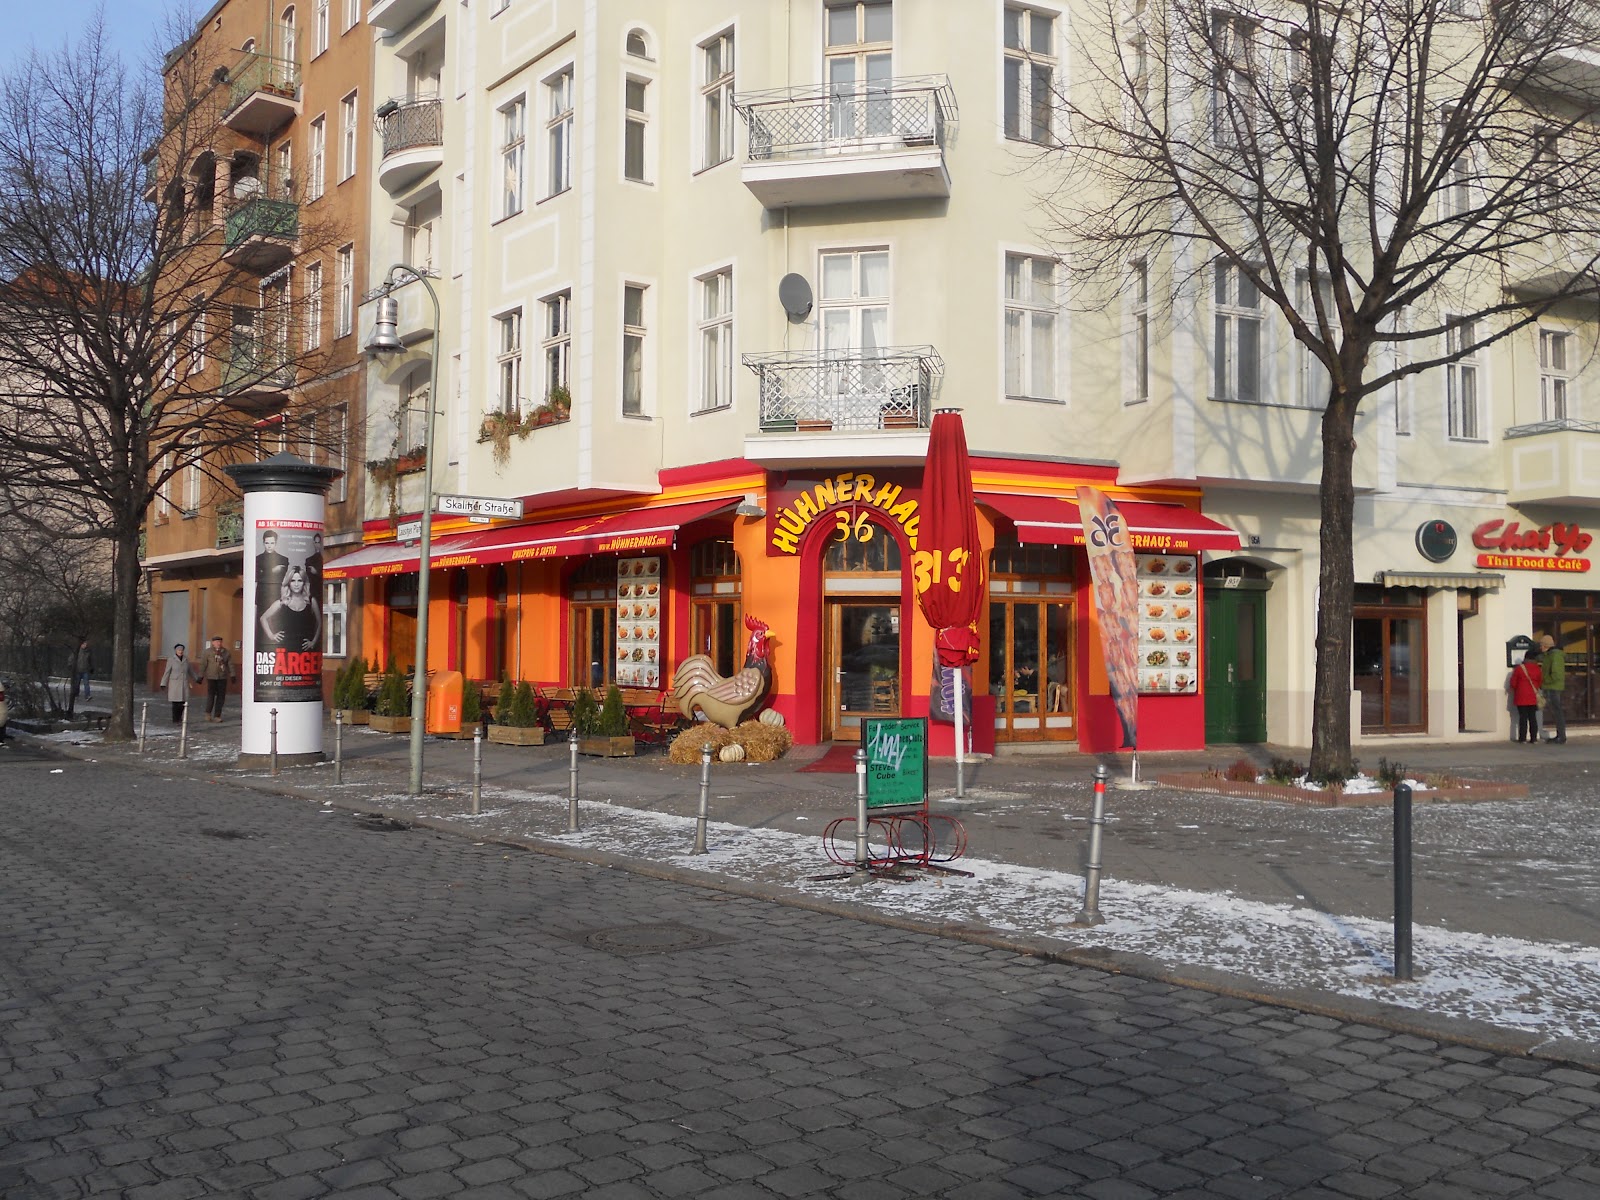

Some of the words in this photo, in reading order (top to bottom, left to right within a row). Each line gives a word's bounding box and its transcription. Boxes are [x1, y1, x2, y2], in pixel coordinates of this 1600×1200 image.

[485, 502, 514, 514] Straße
[772, 472, 919, 554] HÜHNERHAU
[834, 510, 874, 543] 36
[1130, 534, 1172, 548] ERHAUS
[1472, 519, 1552, 552] Chai
[1552, 522, 1593, 557] Yo
[1486, 556, 1513, 567] Thai
[1516, 557, 1546, 568] Food
[1547, 557, 1555, 568] &
[1557, 558, 1582, 570] Café
[256, 652, 275, 665] DAS
[256, 664, 274, 675] GIBT
[876, 772, 896, 780] Cube
